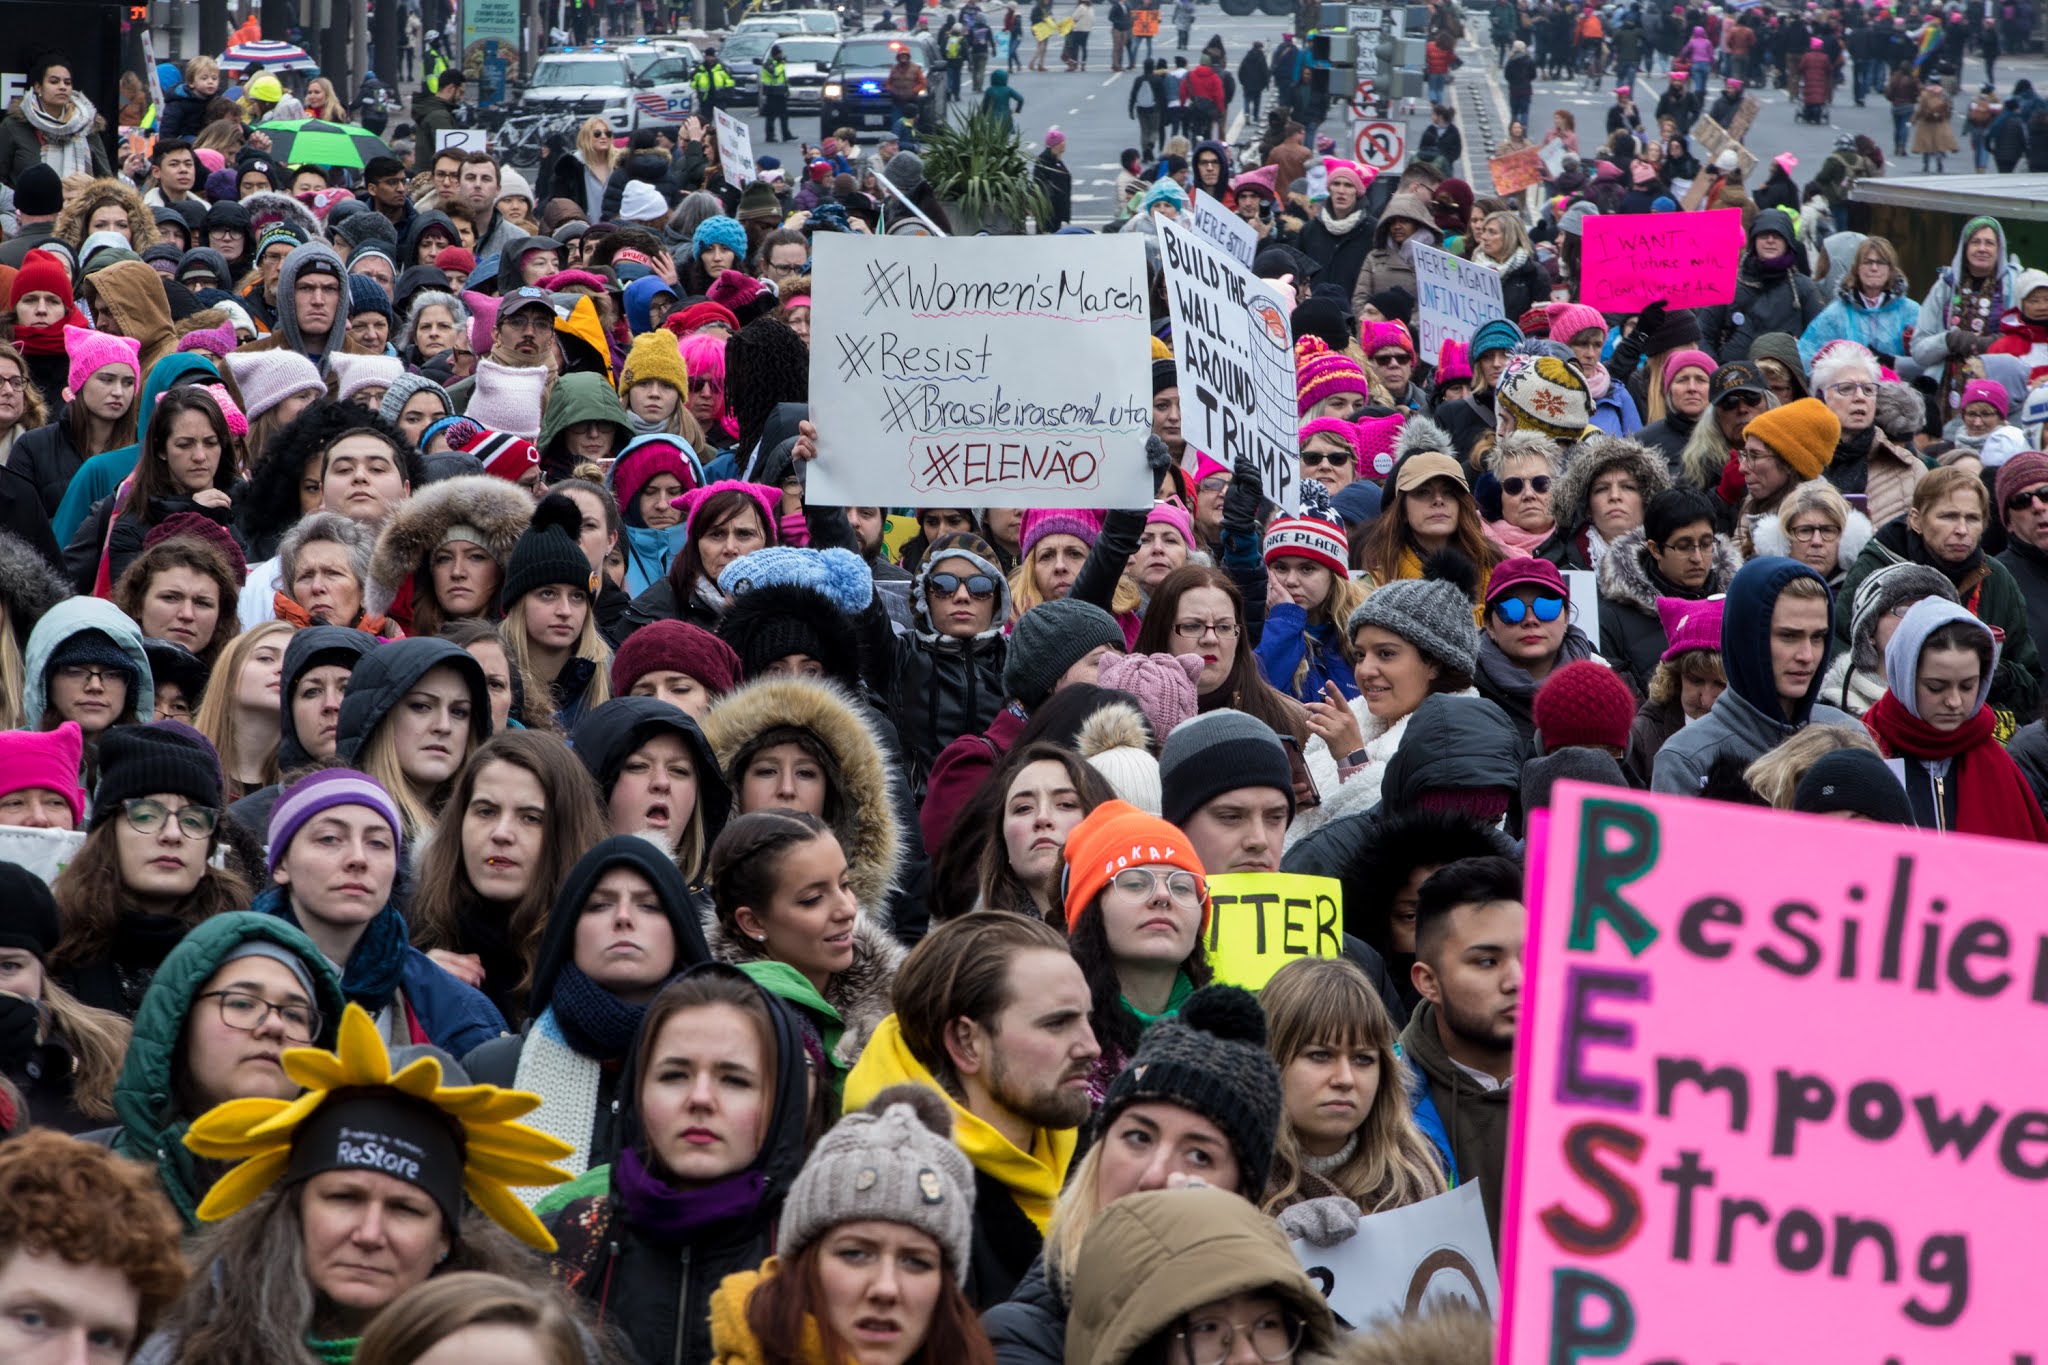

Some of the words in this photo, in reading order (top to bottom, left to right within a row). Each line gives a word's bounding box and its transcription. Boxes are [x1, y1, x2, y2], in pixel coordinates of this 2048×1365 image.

[1351, 11, 1377, 22] THRU
[1618, 229, 1686, 251] WANT
[864, 259, 1143, 316] #Women'sMarch
[1163, 226, 1219, 290] BUILD
[1220, 263, 1248, 310] THE
[1416, 248, 1450, 280] HERE
[1457, 265, 1500, 301] AGAIN
[836, 332, 992, 382] #Resist
[1185, 330, 1256, 415] AROUND
[922, 440, 1097, 487] #ELENÃO
[1196, 384, 1291, 504] TRUMP
[1265, 532, 1289, 549] AKE
[337, 1141, 420, 1179] ReStore
[1537, 1119, 1973, 1328] Strong
